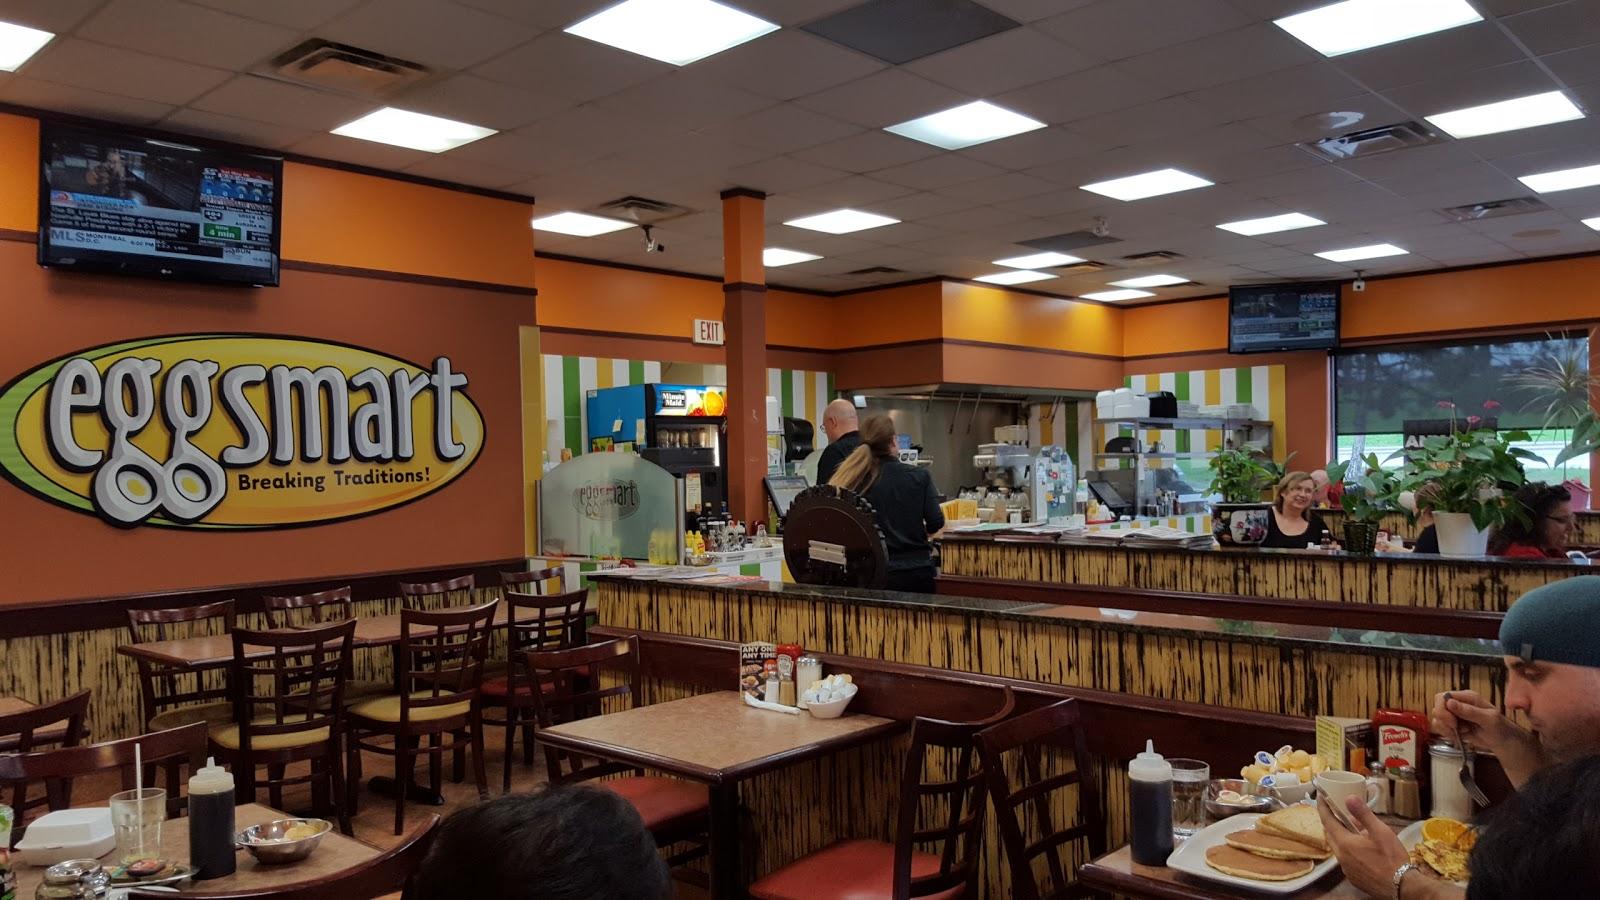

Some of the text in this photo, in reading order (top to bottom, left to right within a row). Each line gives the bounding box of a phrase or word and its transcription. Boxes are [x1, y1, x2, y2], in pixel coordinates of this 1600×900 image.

[51, 229, 86, 243] MLS
[86, 232, 127, 242] MONTREAL
[209, 228, 216, 236] 4
[217, 229, 236, 239] min
[700, 320, 720, 342] EXIT
[662, 391, 686, 401] Minute
[47, 356, 468, 528] eggsmart
[238, 467, 431, 492] Breaking Traditions!
